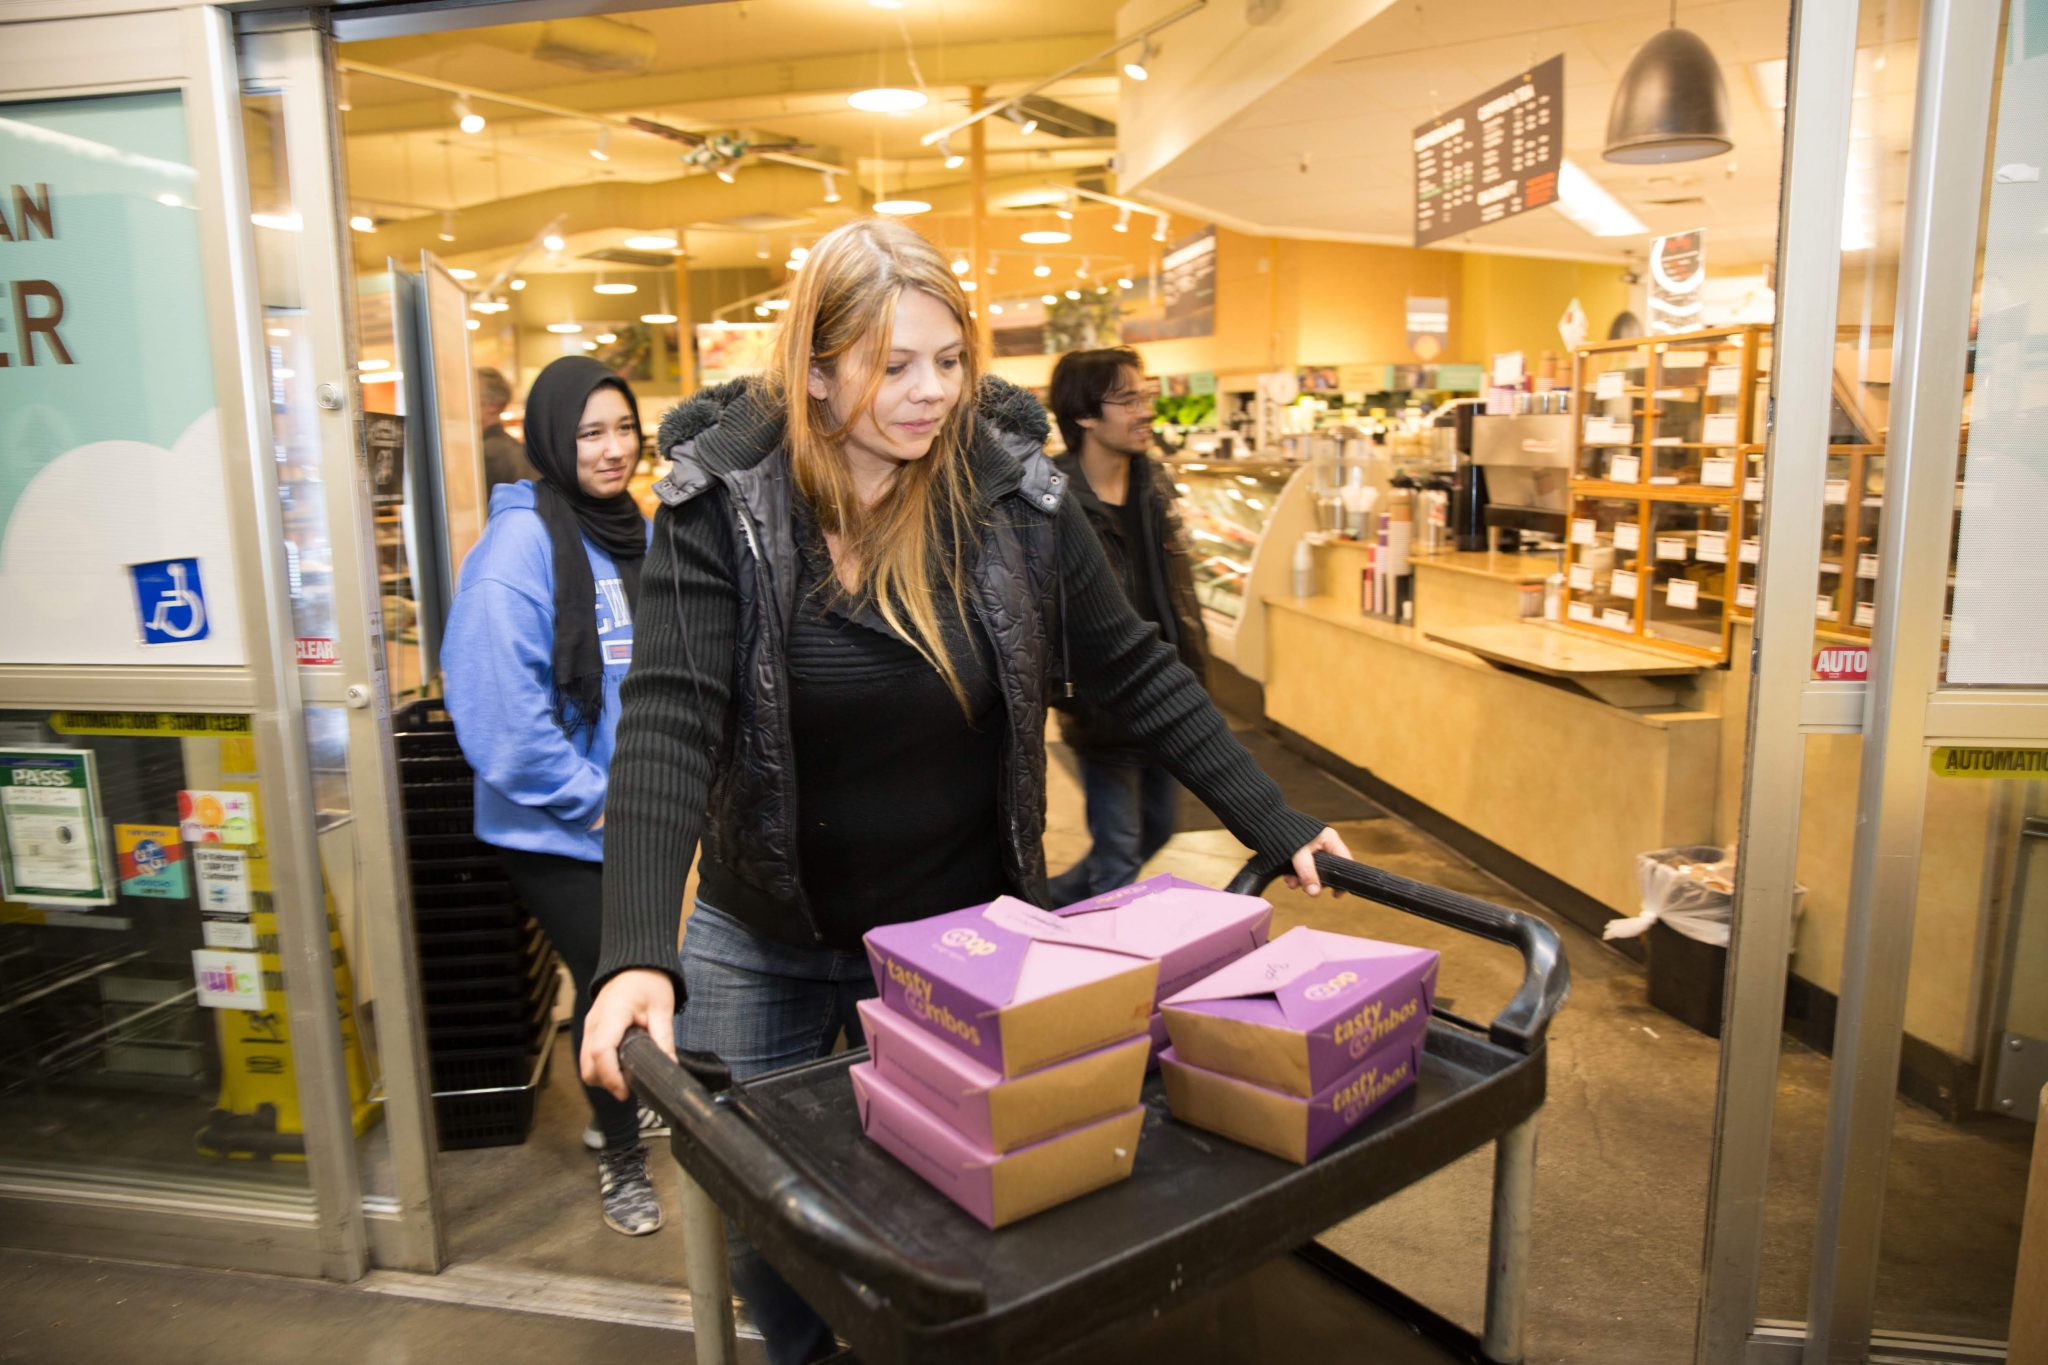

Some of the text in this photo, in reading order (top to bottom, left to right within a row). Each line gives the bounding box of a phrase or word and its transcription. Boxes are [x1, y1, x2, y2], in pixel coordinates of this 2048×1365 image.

[0, 279, 75, 368] R
[1816, 650, 1868, 673] AUTO
[12, 768, 72, 786] PASS
[887, 957, 932, 1003] tasty
[1333, 1000, 1382, 1046] tasty
[1333, 1067, 1378, 1113] tasty
